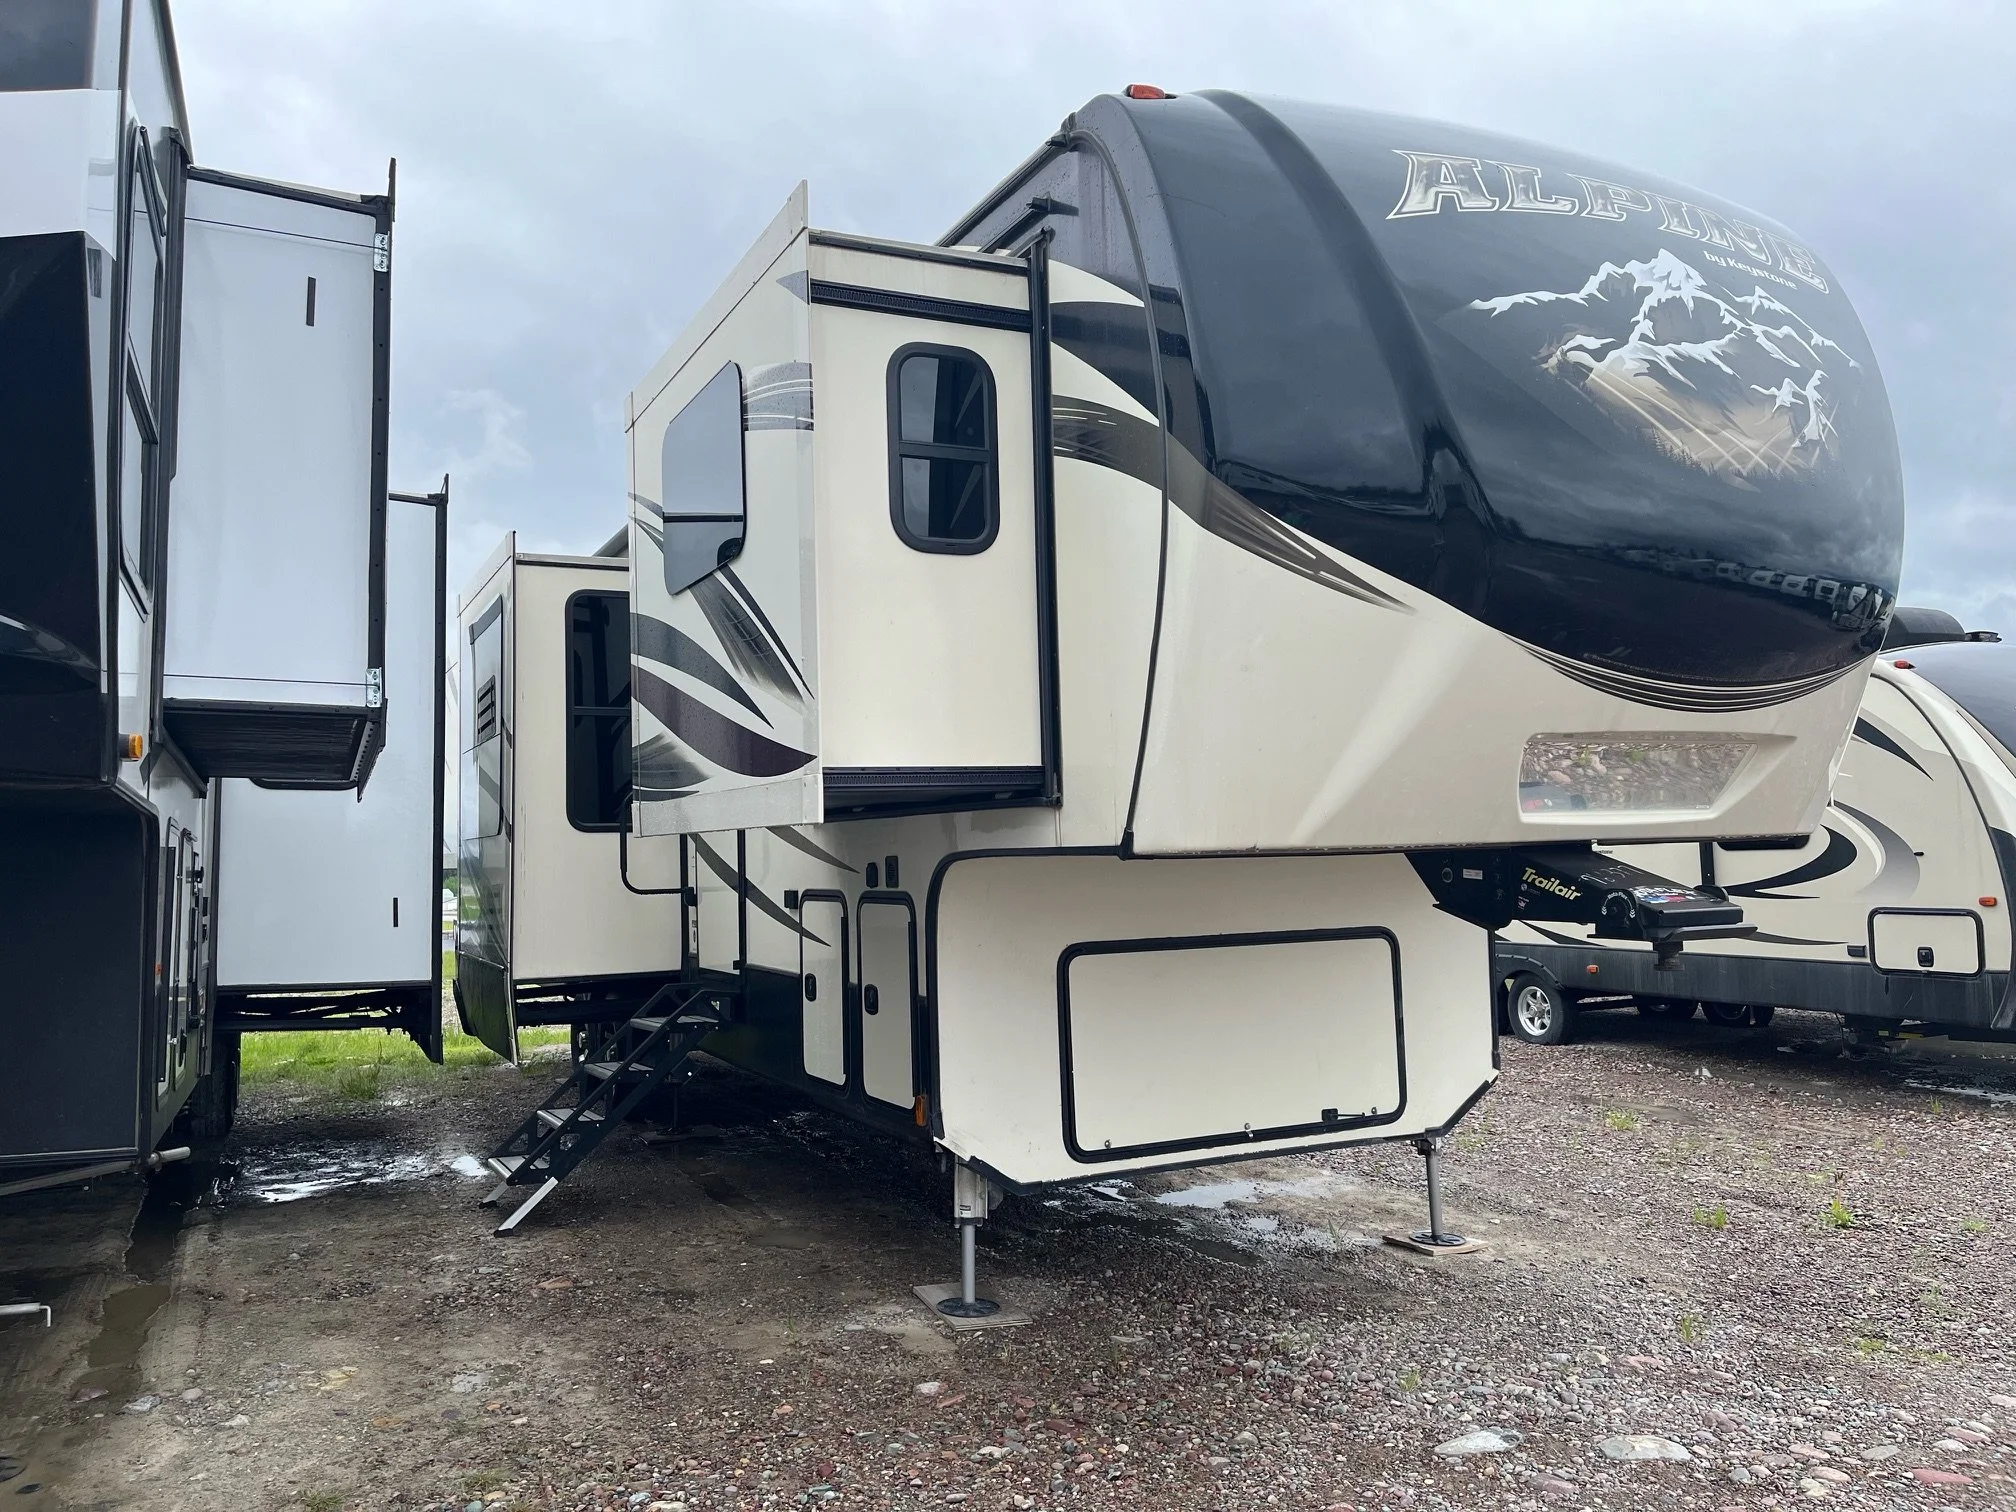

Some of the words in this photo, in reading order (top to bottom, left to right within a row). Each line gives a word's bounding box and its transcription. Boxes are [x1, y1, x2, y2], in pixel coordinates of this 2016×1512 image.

[1386, 149, 1828, 293] ALPINE
[1703, 250, 1726, 267] by
[1726, 257, 1799, 290] Keystone
[1522, 867, 1581, 900] Trailair
